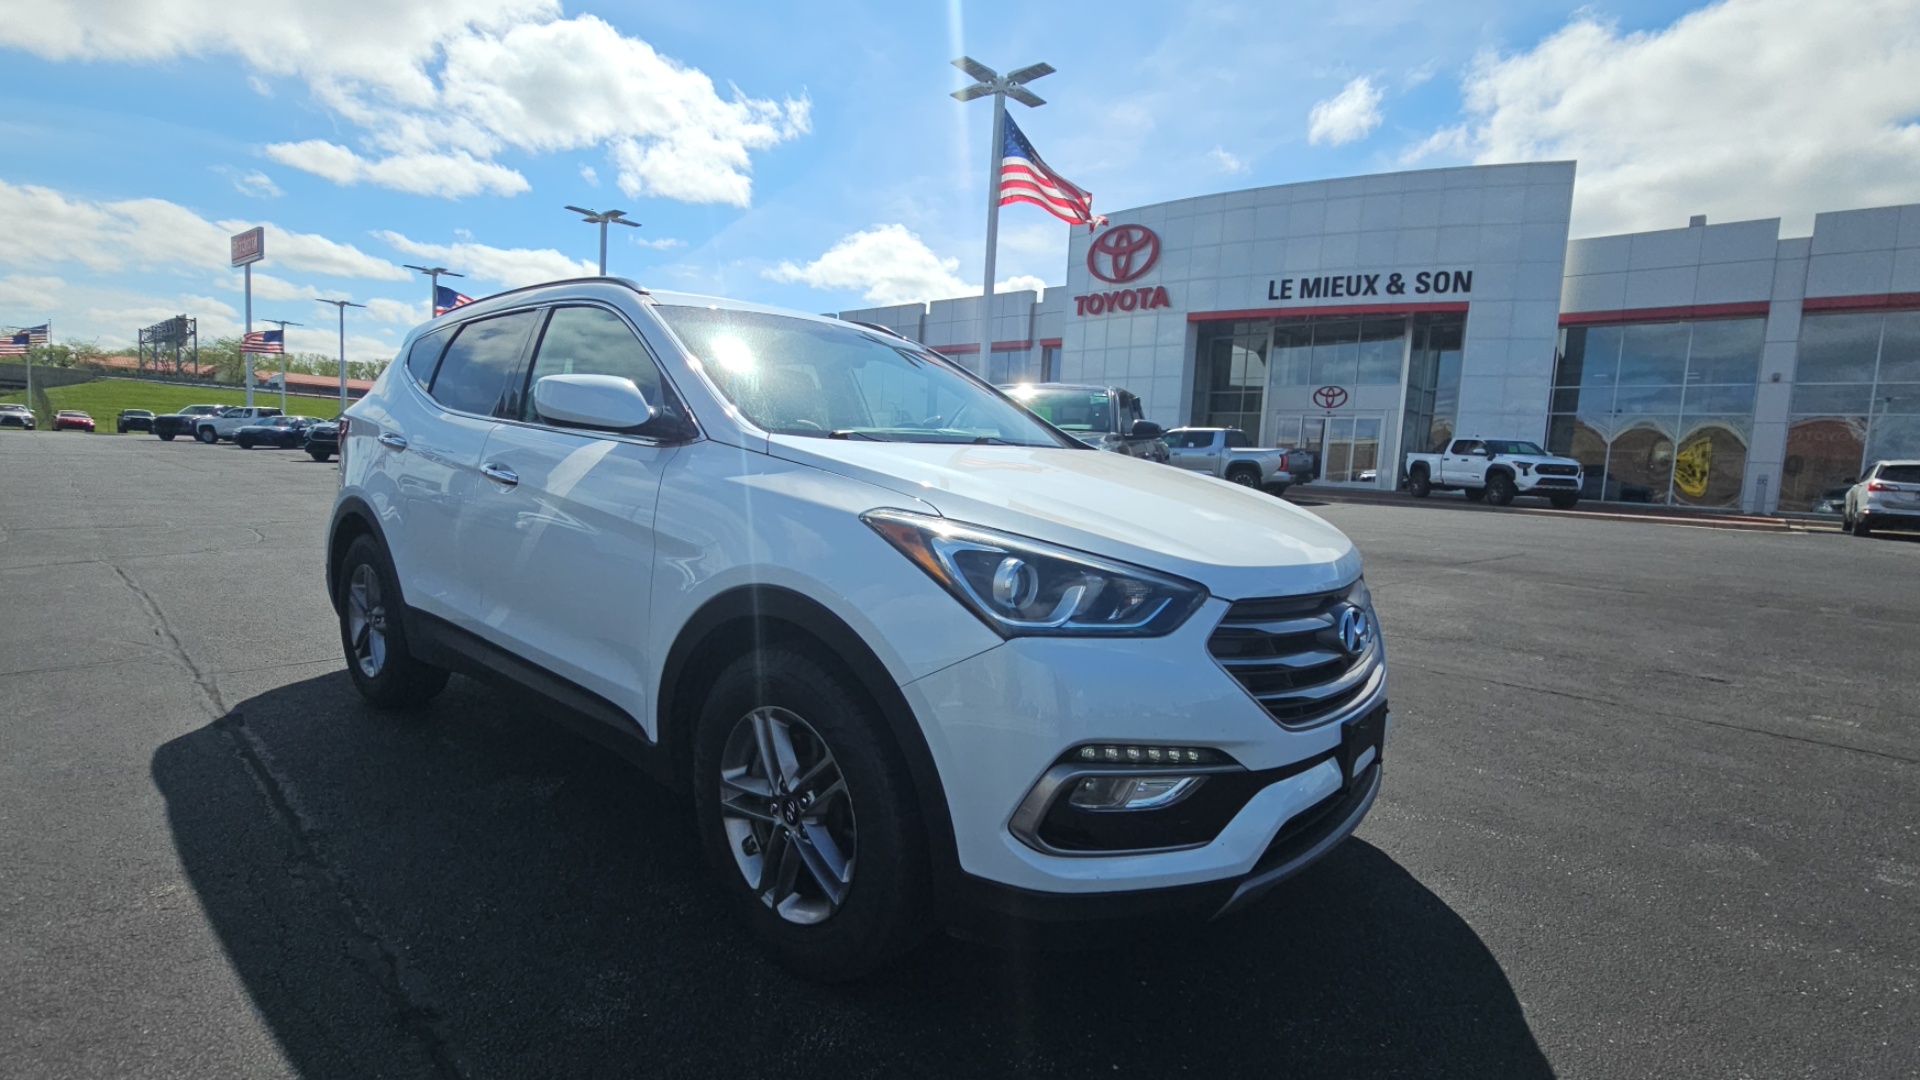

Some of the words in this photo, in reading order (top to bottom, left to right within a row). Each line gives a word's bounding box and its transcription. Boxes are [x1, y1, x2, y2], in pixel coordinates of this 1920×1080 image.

[1268, 279, 1293, 300] LE
[1299, 274, 1380, 299] MIEUX
[1386, 272, 1406, 295] &
[1414, 270, 1473, 294] SON
[1074, 285, 1170, 316] TOYOTA
